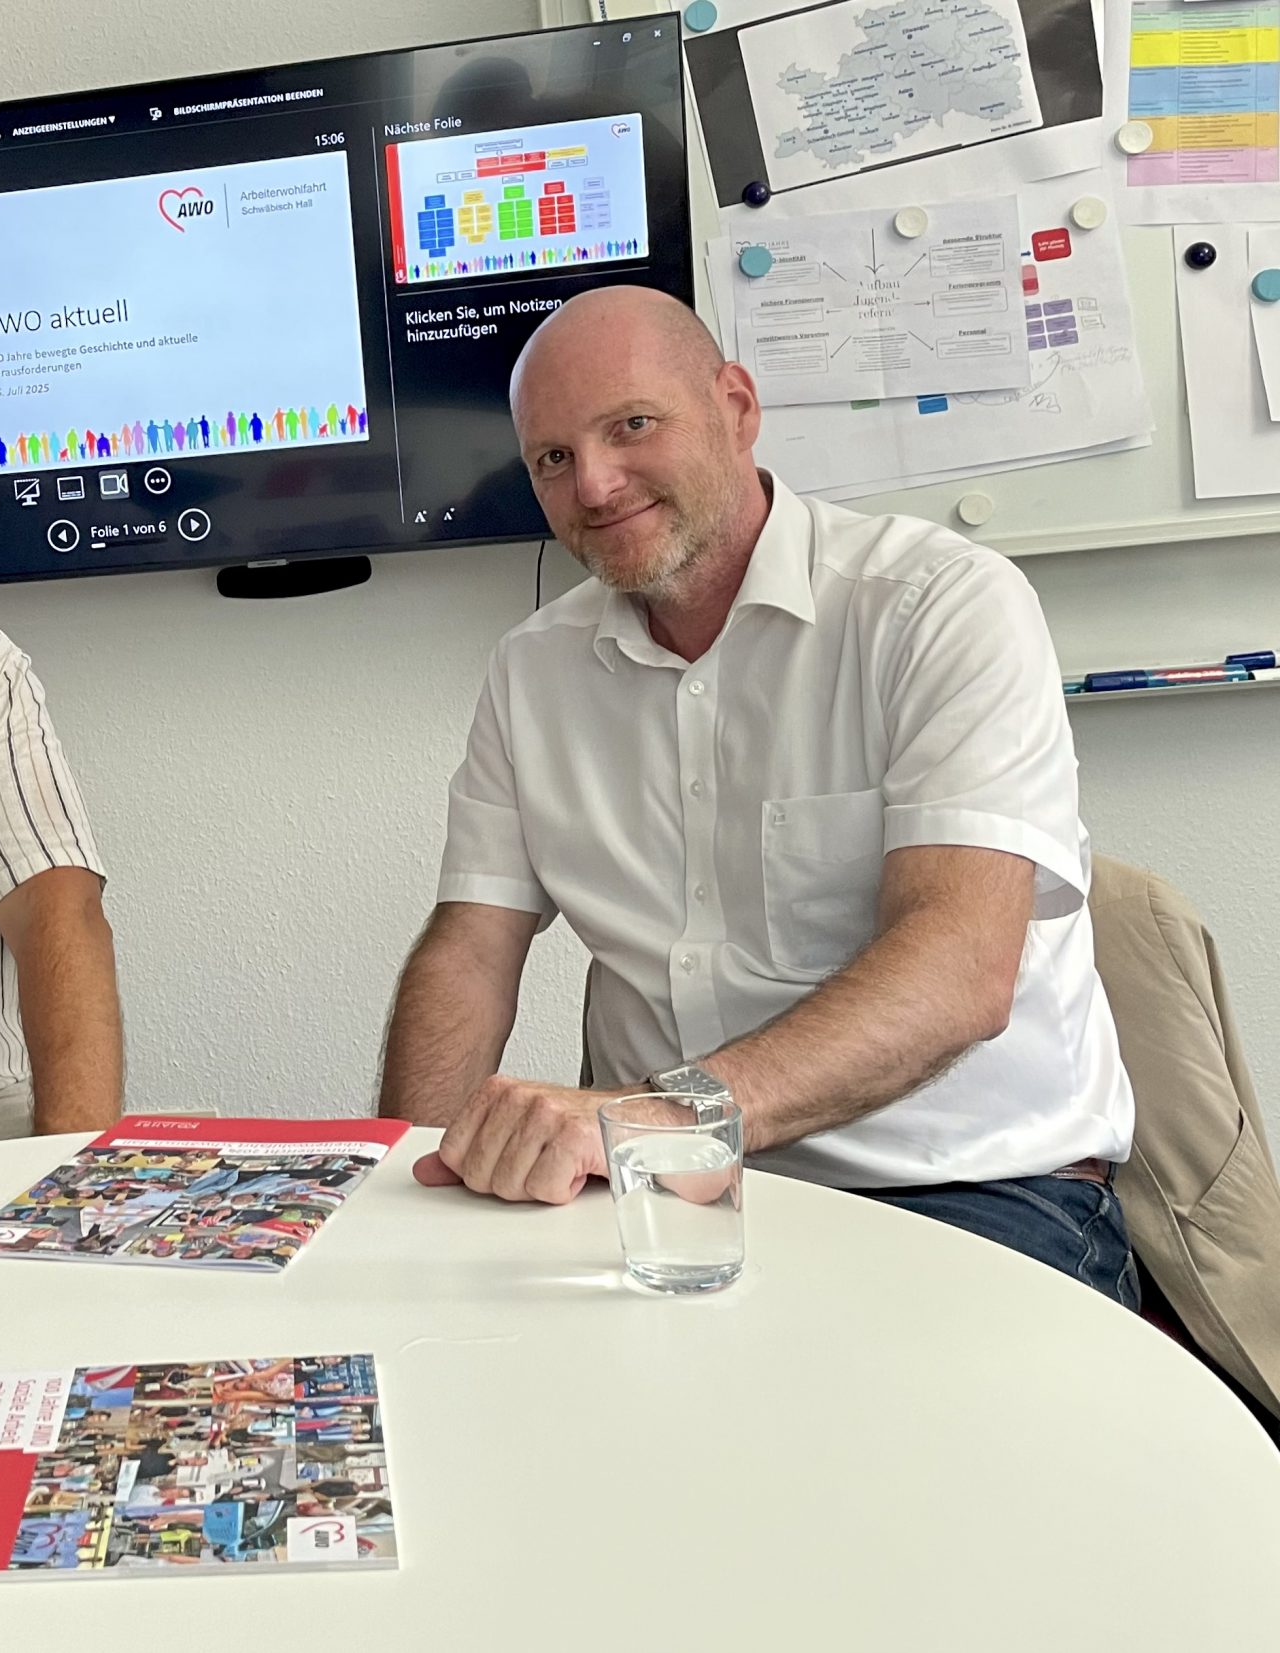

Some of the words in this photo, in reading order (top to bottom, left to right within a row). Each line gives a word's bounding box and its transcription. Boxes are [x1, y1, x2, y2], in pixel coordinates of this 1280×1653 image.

[173, 94, 284, 116] BILDSCHIRMPRÄSENTATION
[285, 89, 324, 101] BEENDEN
[12, 117, 108, 136] ANZEIGEEINSTELLUNGEN
[384, 119, 431, 136] Nächste
[434, 116, 462, 131] Folie
[314, 131, 345, 147] 15:06
[240, 182, 327, 201] Arbeiterwohlfahrt
[177, 200, 214, 219] AWO
[241, 203, 294, 216] Schwäbisch
[295, 199, 313, 209] Hall
[50, 298, 129, 330] aktuell
[405, 307, 453, 326] Klicken
[456, 304, 480, 322] Sie,
[483, 304, 506, 318] um
[509, 298, 563, 314] Notizen
[406, 322, 498, 344] hinzuzufügen
[6, 347, 33, 363] Jahre
[35, 347, 78, 360] bewegte
[79, 340, 134, 355] Geschichte
[136, 337, 156, 349] und
[158, 333, 199, 346] aktuelle
[6, 385, 24, 397] Juli
[25, 383, 50, 395] 2025
[90, 524, 120, 539] Folie
[122, 524, 129, 536] 1
[132, 524, 156, 535] von
[158, 520, 167, 533] 6
